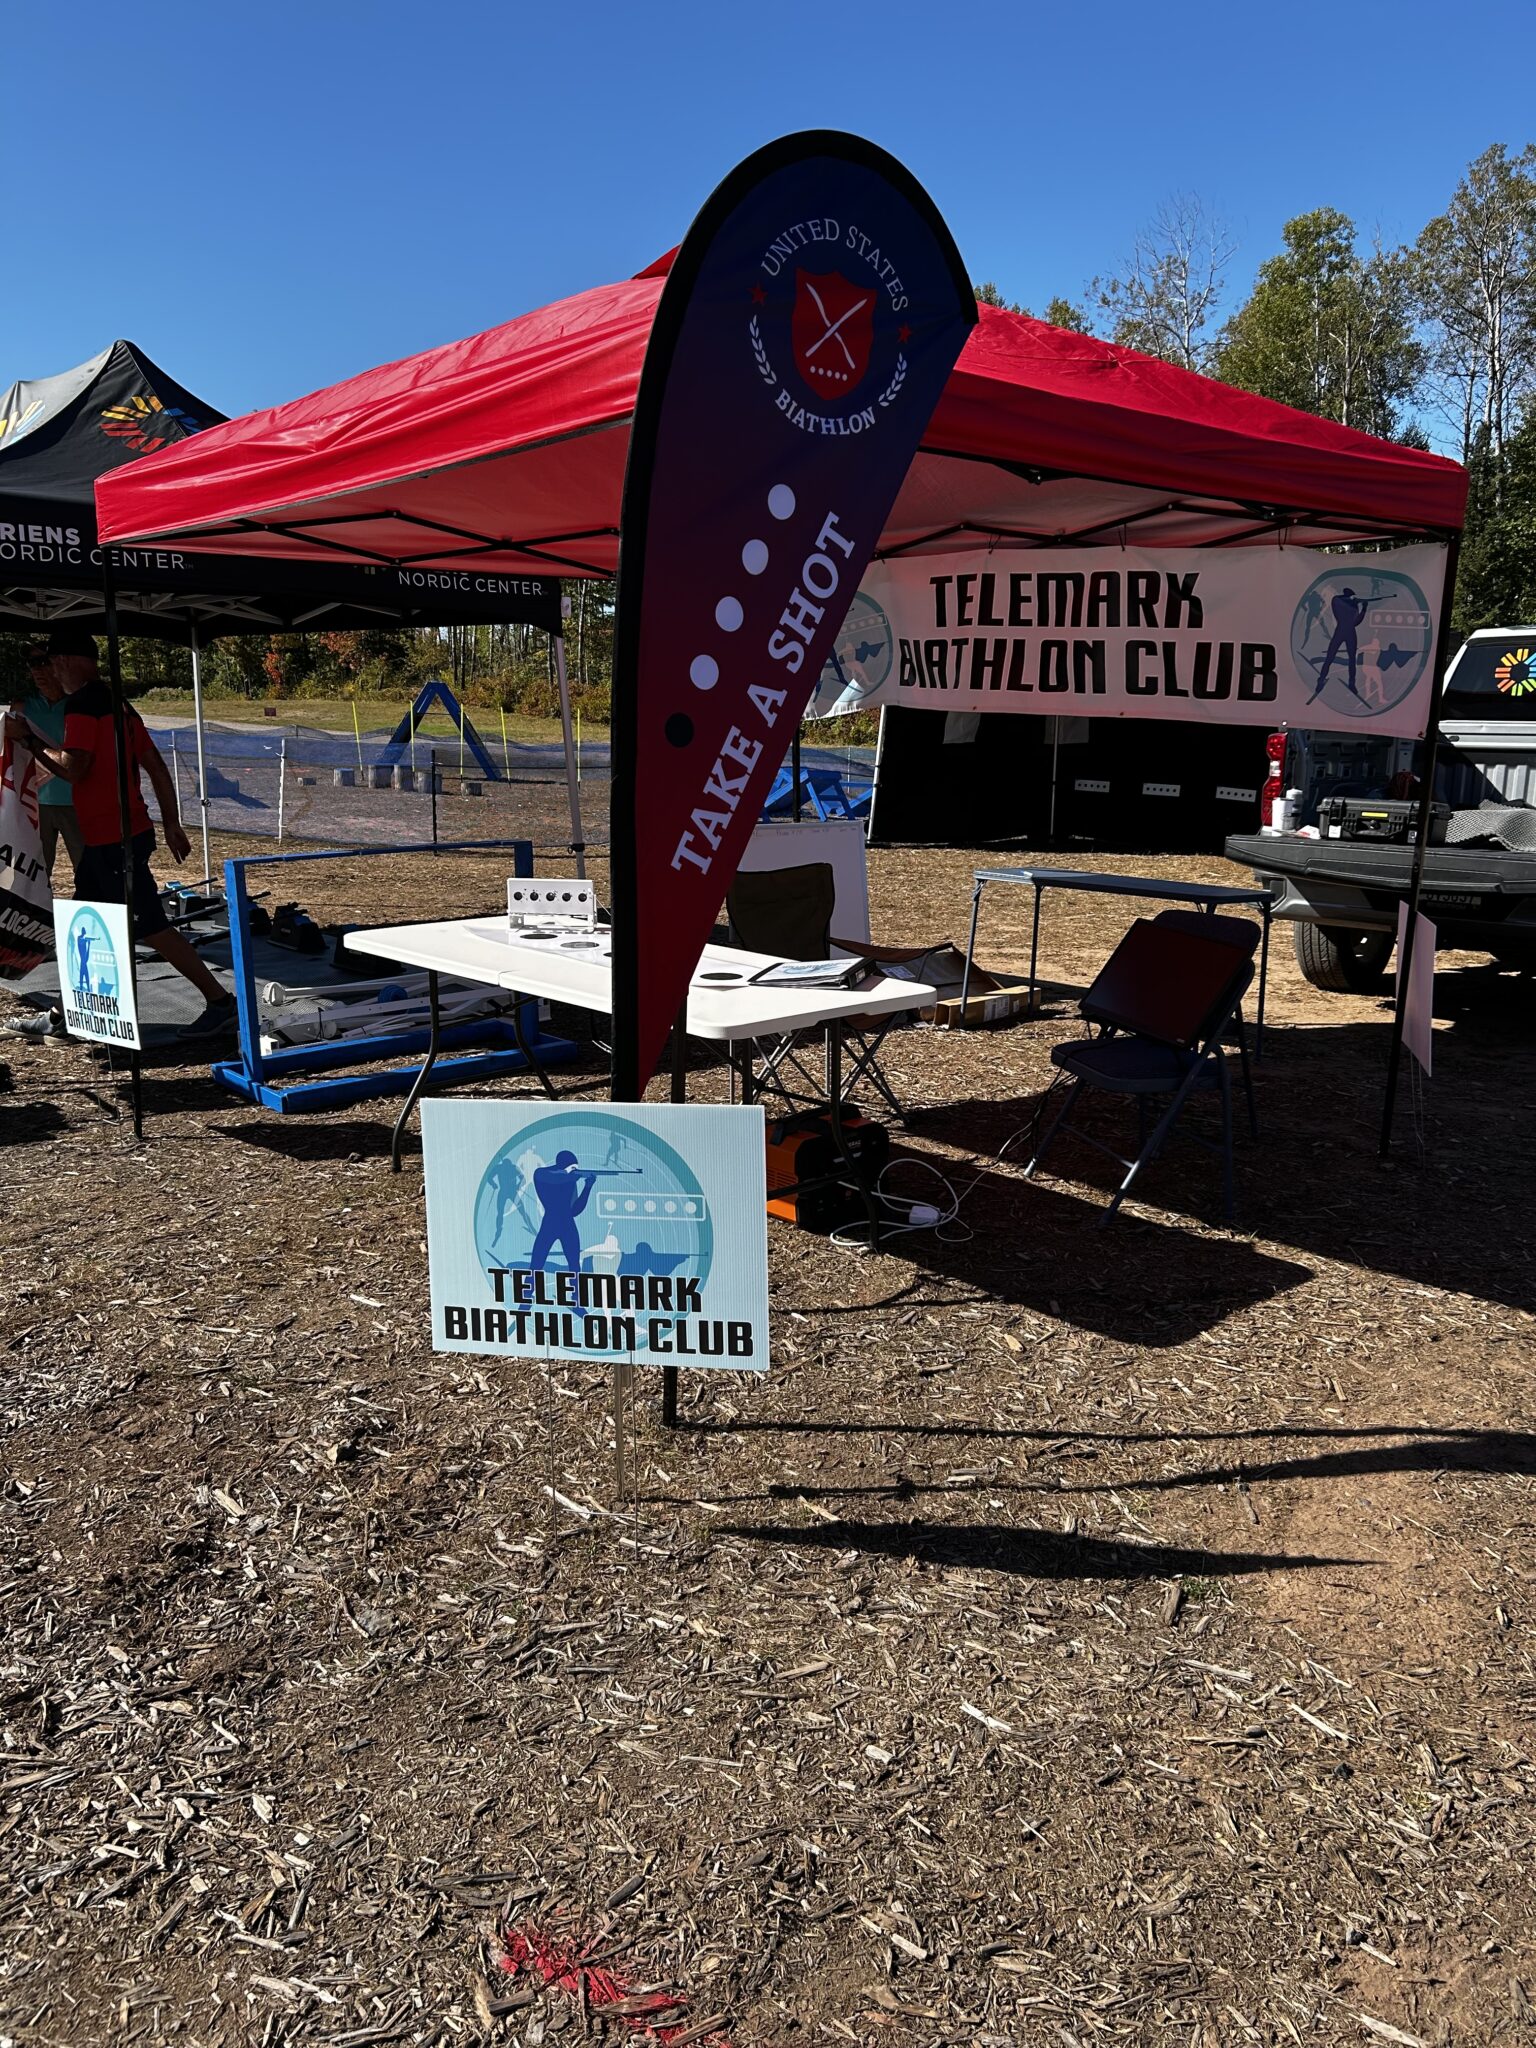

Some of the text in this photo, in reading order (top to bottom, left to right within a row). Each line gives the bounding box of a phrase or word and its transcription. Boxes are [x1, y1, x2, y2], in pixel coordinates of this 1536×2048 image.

[761, 218, 908, 312] UNITED STATES
[775, 388, 876, 435] BIATHLON
[90, 549, 185, 569] CENTER
[398, 571, 543, 596] NORDIC CENTER
[928, 570, 1204, 629] TELEMARK
[670, 511, 856, 876] TAKE A SHOT
[898, 638, 1278, 702] BIATHLON CLUB
[66, 1009, 135, 1041] BIATHLON CLUB
[72, 989, 120, 1016] TELEMARK
[487, 1268, 703, 1313] TELEMARK
[444, 1306, 755, 1357] BIATHLON CLUB
